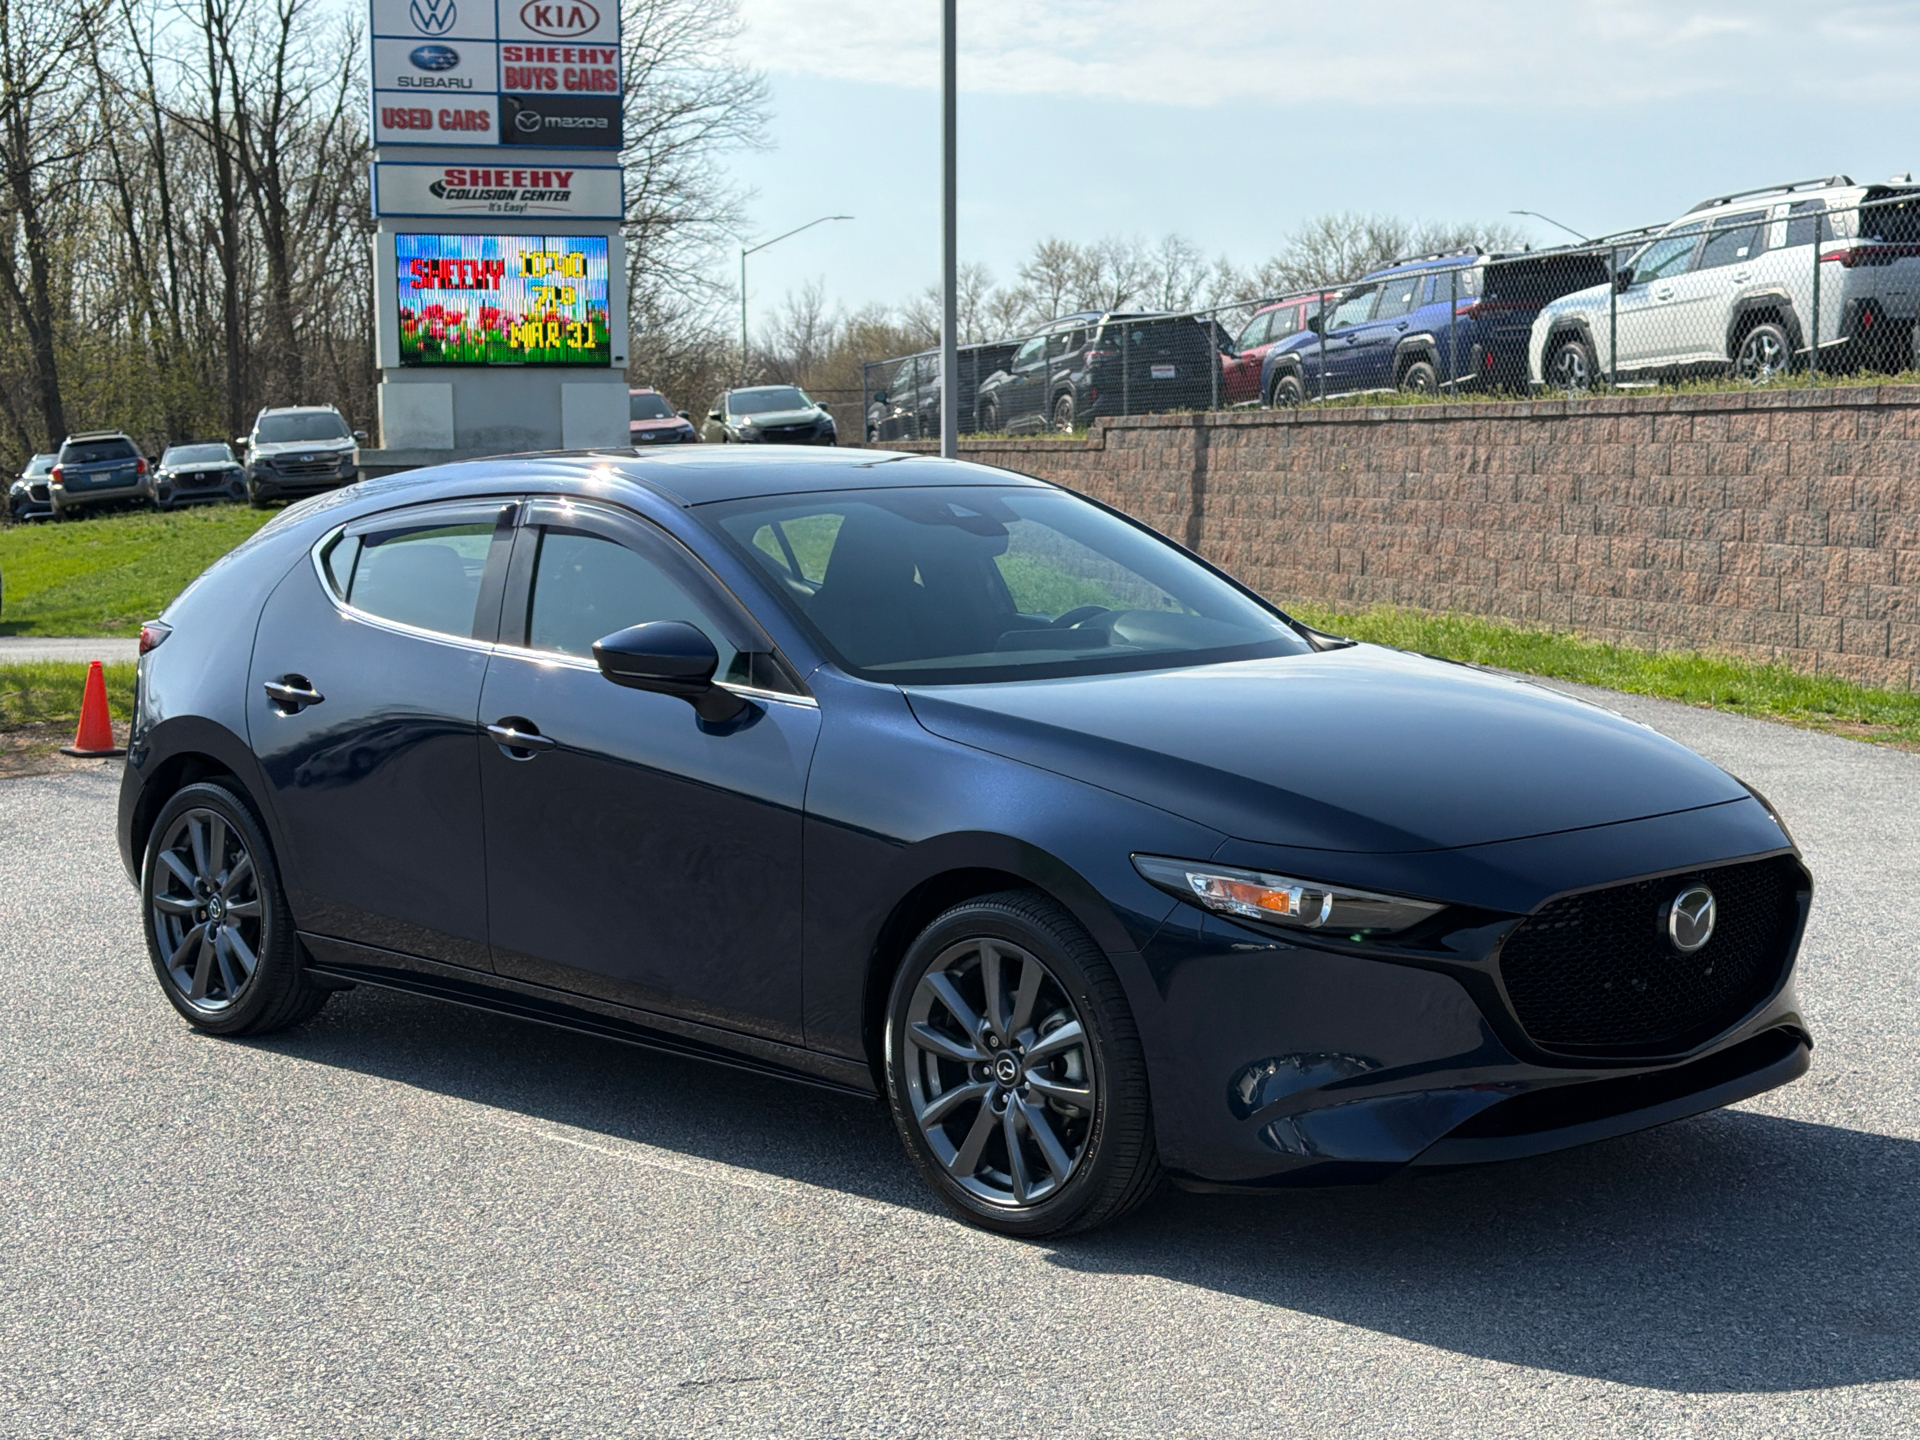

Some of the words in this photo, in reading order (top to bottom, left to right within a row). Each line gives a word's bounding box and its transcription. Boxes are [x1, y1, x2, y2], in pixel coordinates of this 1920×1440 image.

[534, 5, 587, 28] KIA
[503, 46, 617, 65] SHEEHY
[397, 76, 473, 89] SUBARU
[505, 66, 558, 91] BUYS
[563, 68, 618, 92] CARS
[382, 107, 433, 130] USED
[438, 108, 491, 132] CARS
[545, 116, 609, 129] mazda
[444, 169, 574, 188] SHEEHY
[445, 188, 518, 201] COLLISION
[520, 189, 572, 202] CENTER
[488, 202, 502, 213] It's
[503, 202, 528, 214] Easy!
[510, 322, 561, 349] MAR
[566, 322, 596, 348] 31
